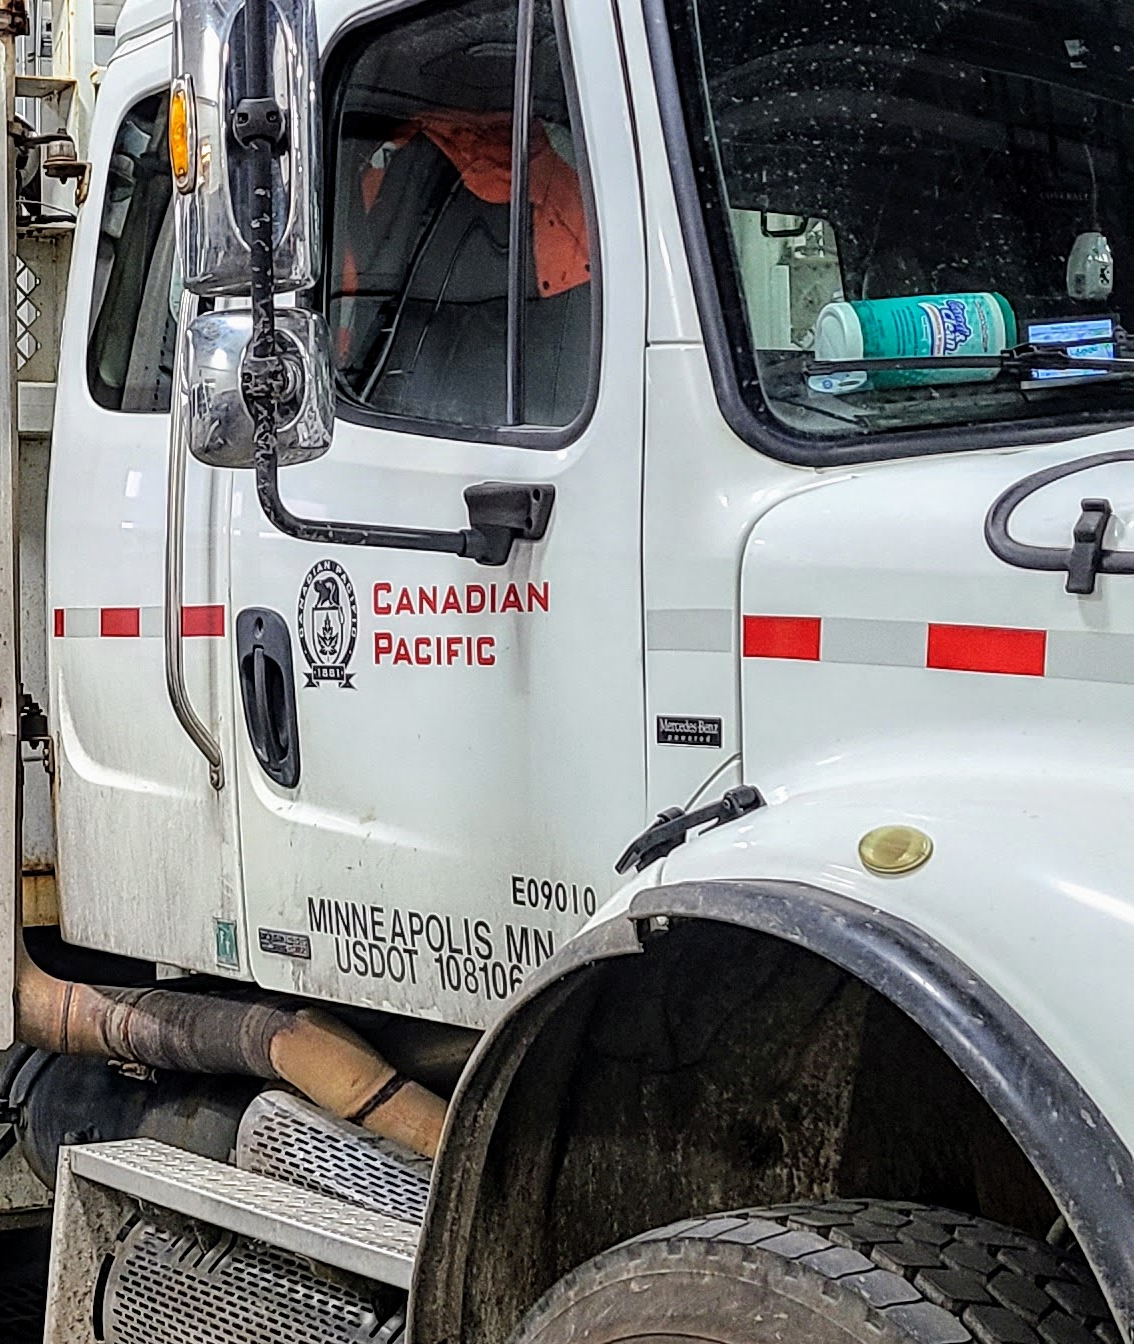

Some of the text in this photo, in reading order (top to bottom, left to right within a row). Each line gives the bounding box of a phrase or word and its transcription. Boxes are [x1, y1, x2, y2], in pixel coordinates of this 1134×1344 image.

[941, 309, 956, 350] Clean
[948, 301, 970, 336] Good
[299, 560, 331, 638] CANADIAN
[373, 582, 549, 615] CANADIAN
[374, 632, 496, 666] PACIFIC
[316, 668, 341, 678] 1881
[511, 875, 597, 918] E09010
[308, 897, 492, 960] MINNEAPOLIS
[506, 924, 553, 968] MN
[335, 937, 418, 984] USDOT
